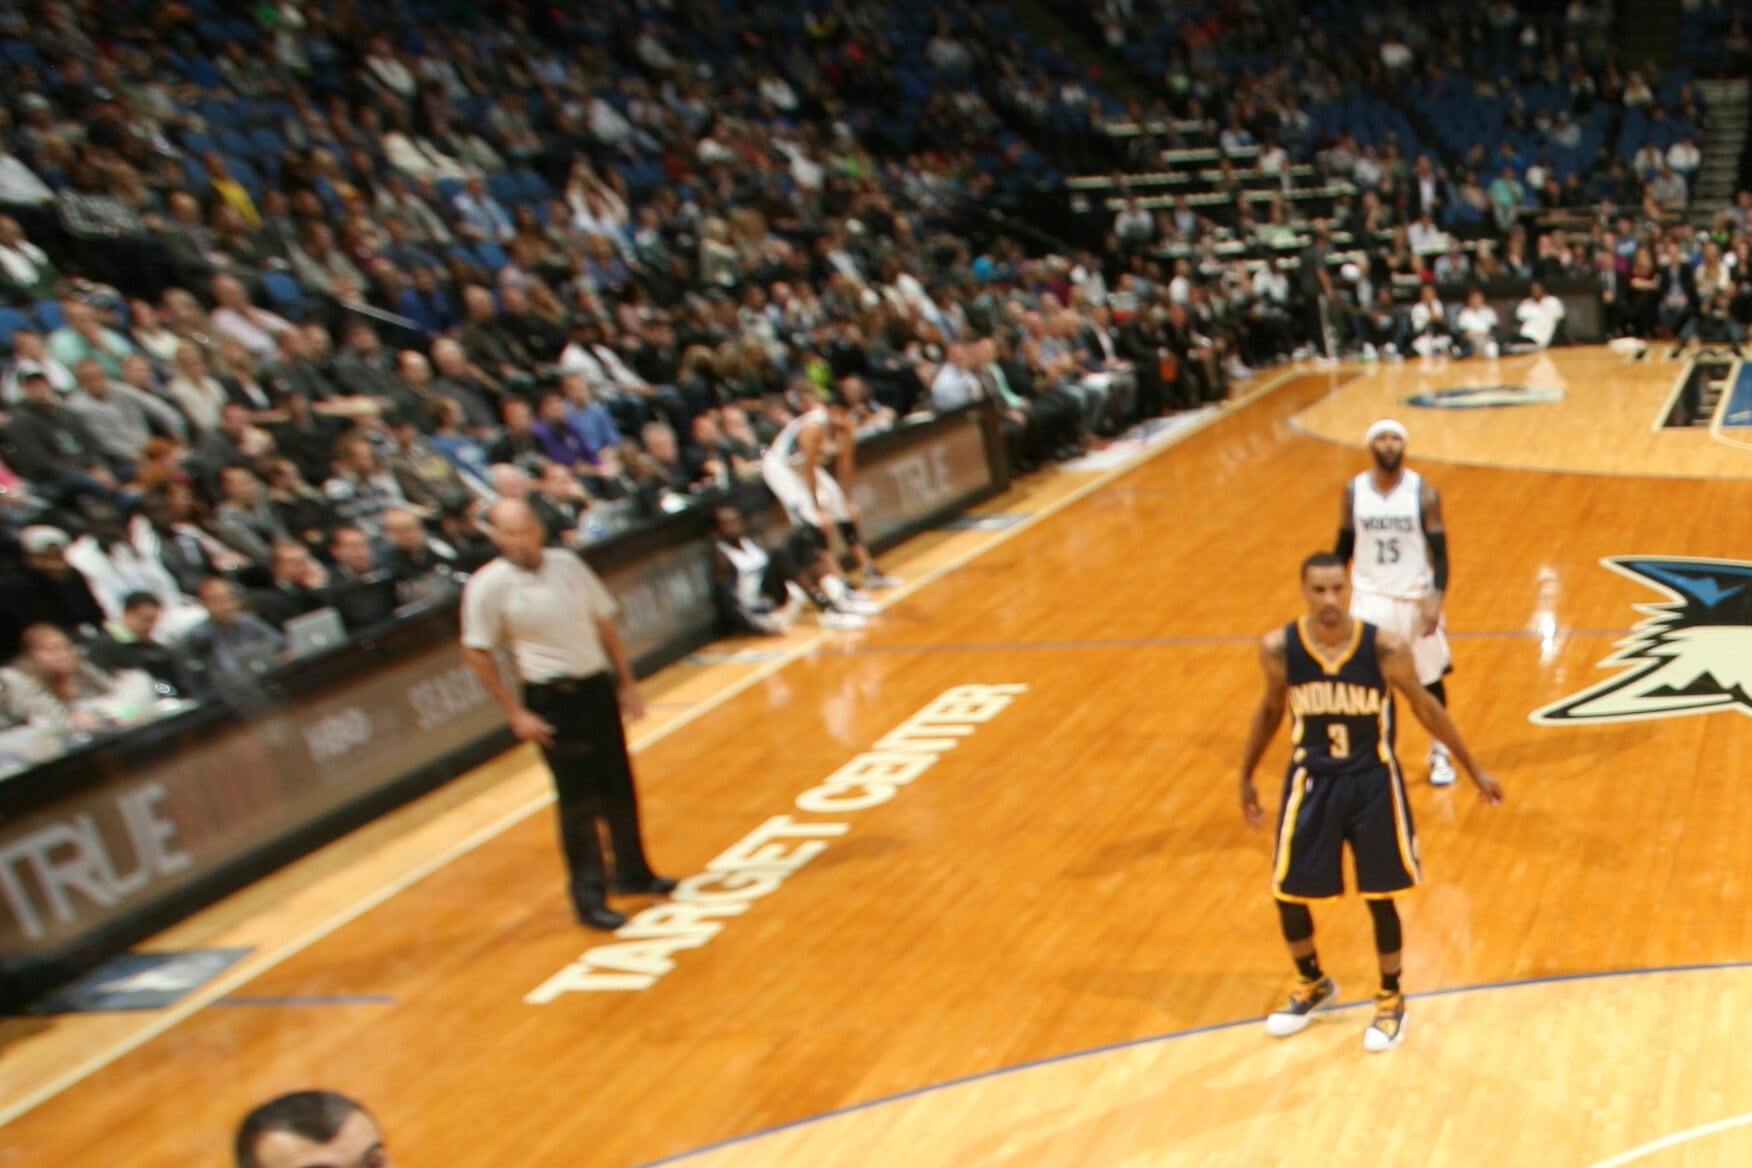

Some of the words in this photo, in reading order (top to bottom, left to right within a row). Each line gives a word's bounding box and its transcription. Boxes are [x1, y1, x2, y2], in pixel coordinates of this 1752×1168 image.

[1375, 538, 1400, 564] 15
[1289, 681, 1380, 716] INDIANA
[1327, 722, 1350, 759] 3
[0, 781, 194, 941] TRUE
[523, 814, 852, 1004] TARGET
[795, 682, 1029, 813] CENTER
